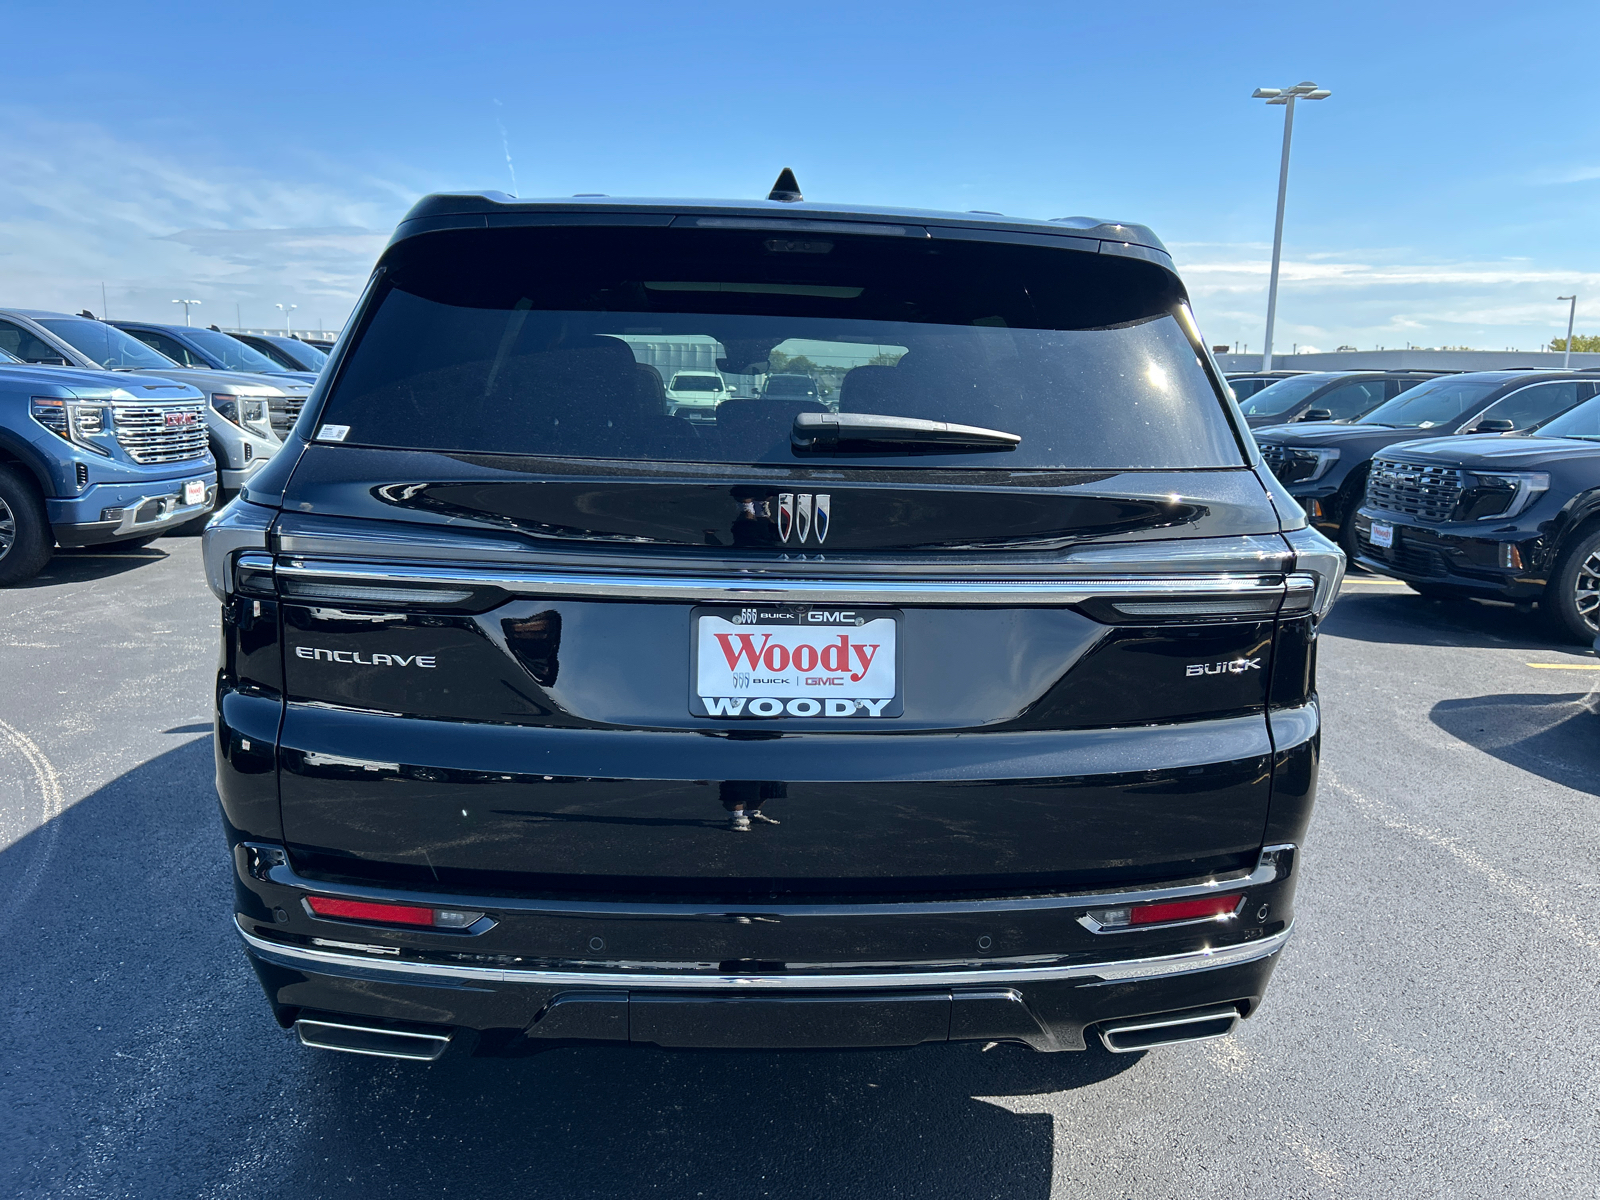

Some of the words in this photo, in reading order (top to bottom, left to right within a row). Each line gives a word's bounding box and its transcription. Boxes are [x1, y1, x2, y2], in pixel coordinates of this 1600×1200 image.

[167, 413, 197, 426] GMC
[807, 611, 856, 622] GMC
[295, 646, 436, 668] ENCLAVE
[713, 633, 880, 682] Woody
[1185, 657, 1261, 677] BUICK
[805, 677, 844, 686] GMC
[701, 697, 892, 717] WOODY
